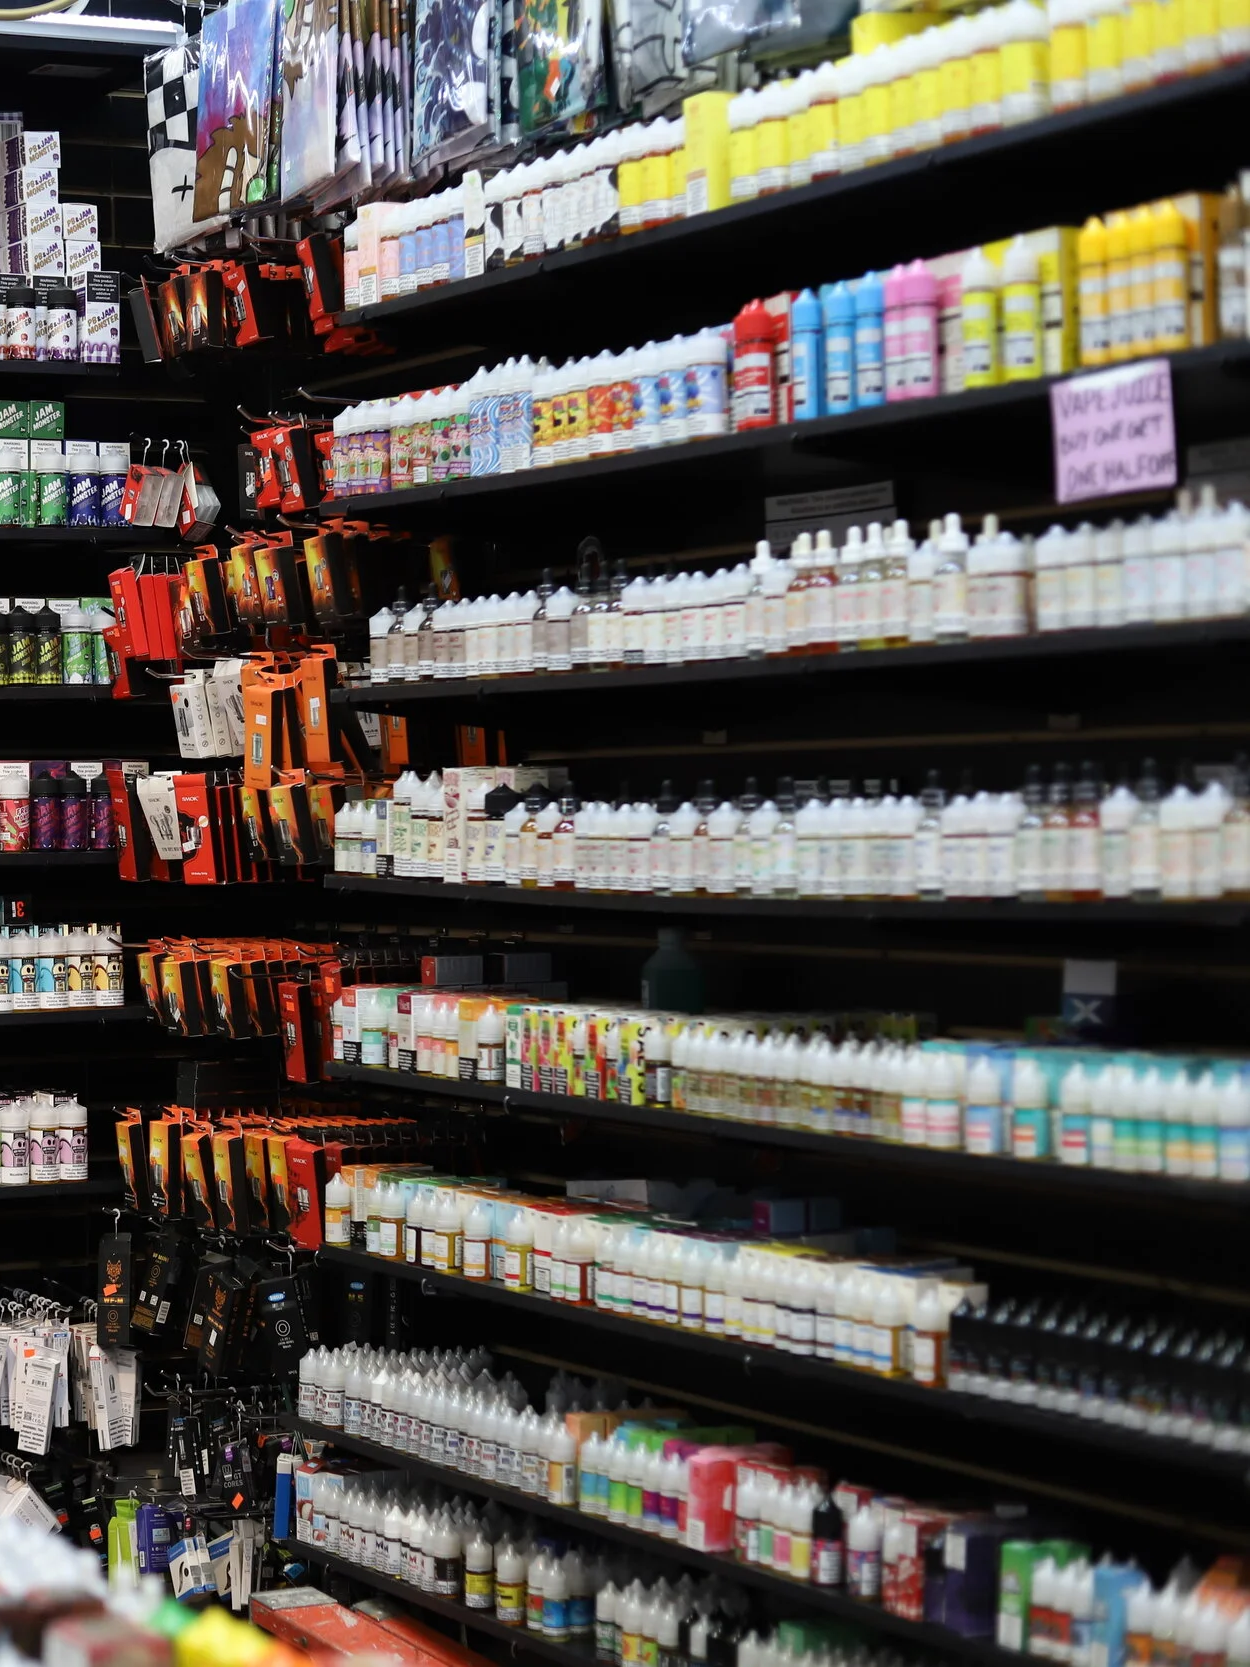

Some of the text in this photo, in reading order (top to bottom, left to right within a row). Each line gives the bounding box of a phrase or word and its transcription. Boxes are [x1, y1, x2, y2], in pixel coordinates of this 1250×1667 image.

[29, 141, 58, 163] MONSTER
[26, 178, 57, 199] MONSTER
[30, 214, 61, 234] MONSTER
[67, 215, 96, 235] MONSTER
[34, 250, 62, 270] MONSTER
[69, 251, 99, 270] MONSTER
[88, 314, 119, 336] MONSTER
[35, 404, 53, 422] JAM
[1060, 390, 1105, 418] VAPE
[33, 410, 61, 431] MONSTER
[1061, 415, 1164, 454] BUY ONE GET
[1068, 462, 1098, 492] ONE
[1103, 456, 1145, 483] HALF
[43, 478, 62, 495] JAM
[71, 485, 98, 507] MONSTER
[72, 477, 91, 495] JAM
[101, 482, 119, 499] JAM
[223, 1479, 244, 1488] CORES
